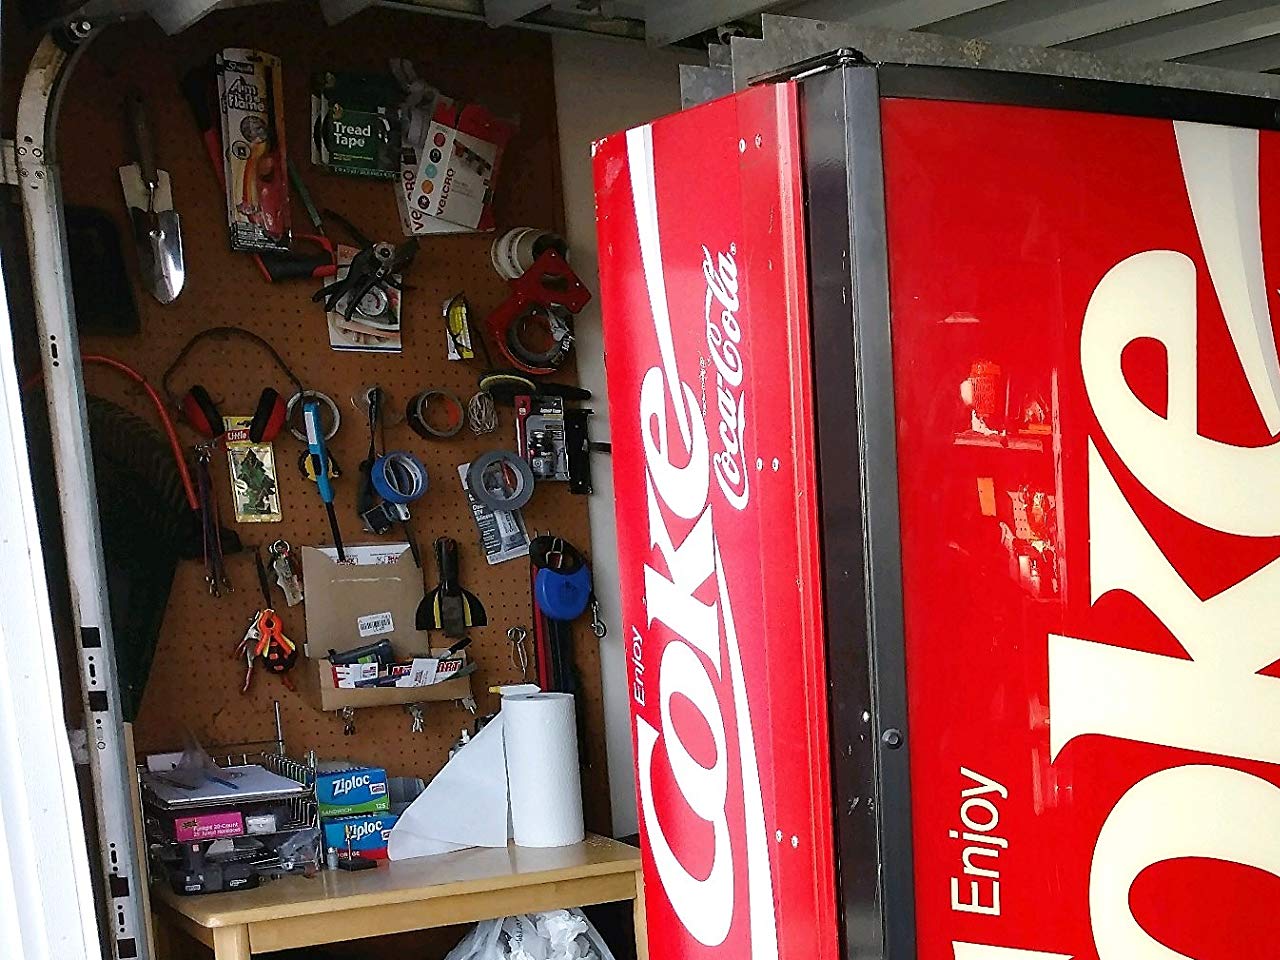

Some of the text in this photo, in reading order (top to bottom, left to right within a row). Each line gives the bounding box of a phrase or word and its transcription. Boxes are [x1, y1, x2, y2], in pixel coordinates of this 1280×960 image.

[229, 93, 265, 113] Flame
[333, 121, 371, 137] Tread
[333, 132, 365, 149] Tape
[703, 243, 750, 512] Coca-Cola
[227, 430, 247, 441] Little
[631, 625, 648, 707] Enjoy
[636, 366, 735, 948] Coke
[332, 775, 370, 796] Ziploc
[375, 802, 386, 810] 125
[950, 765, 1009, 917] Enjoy
